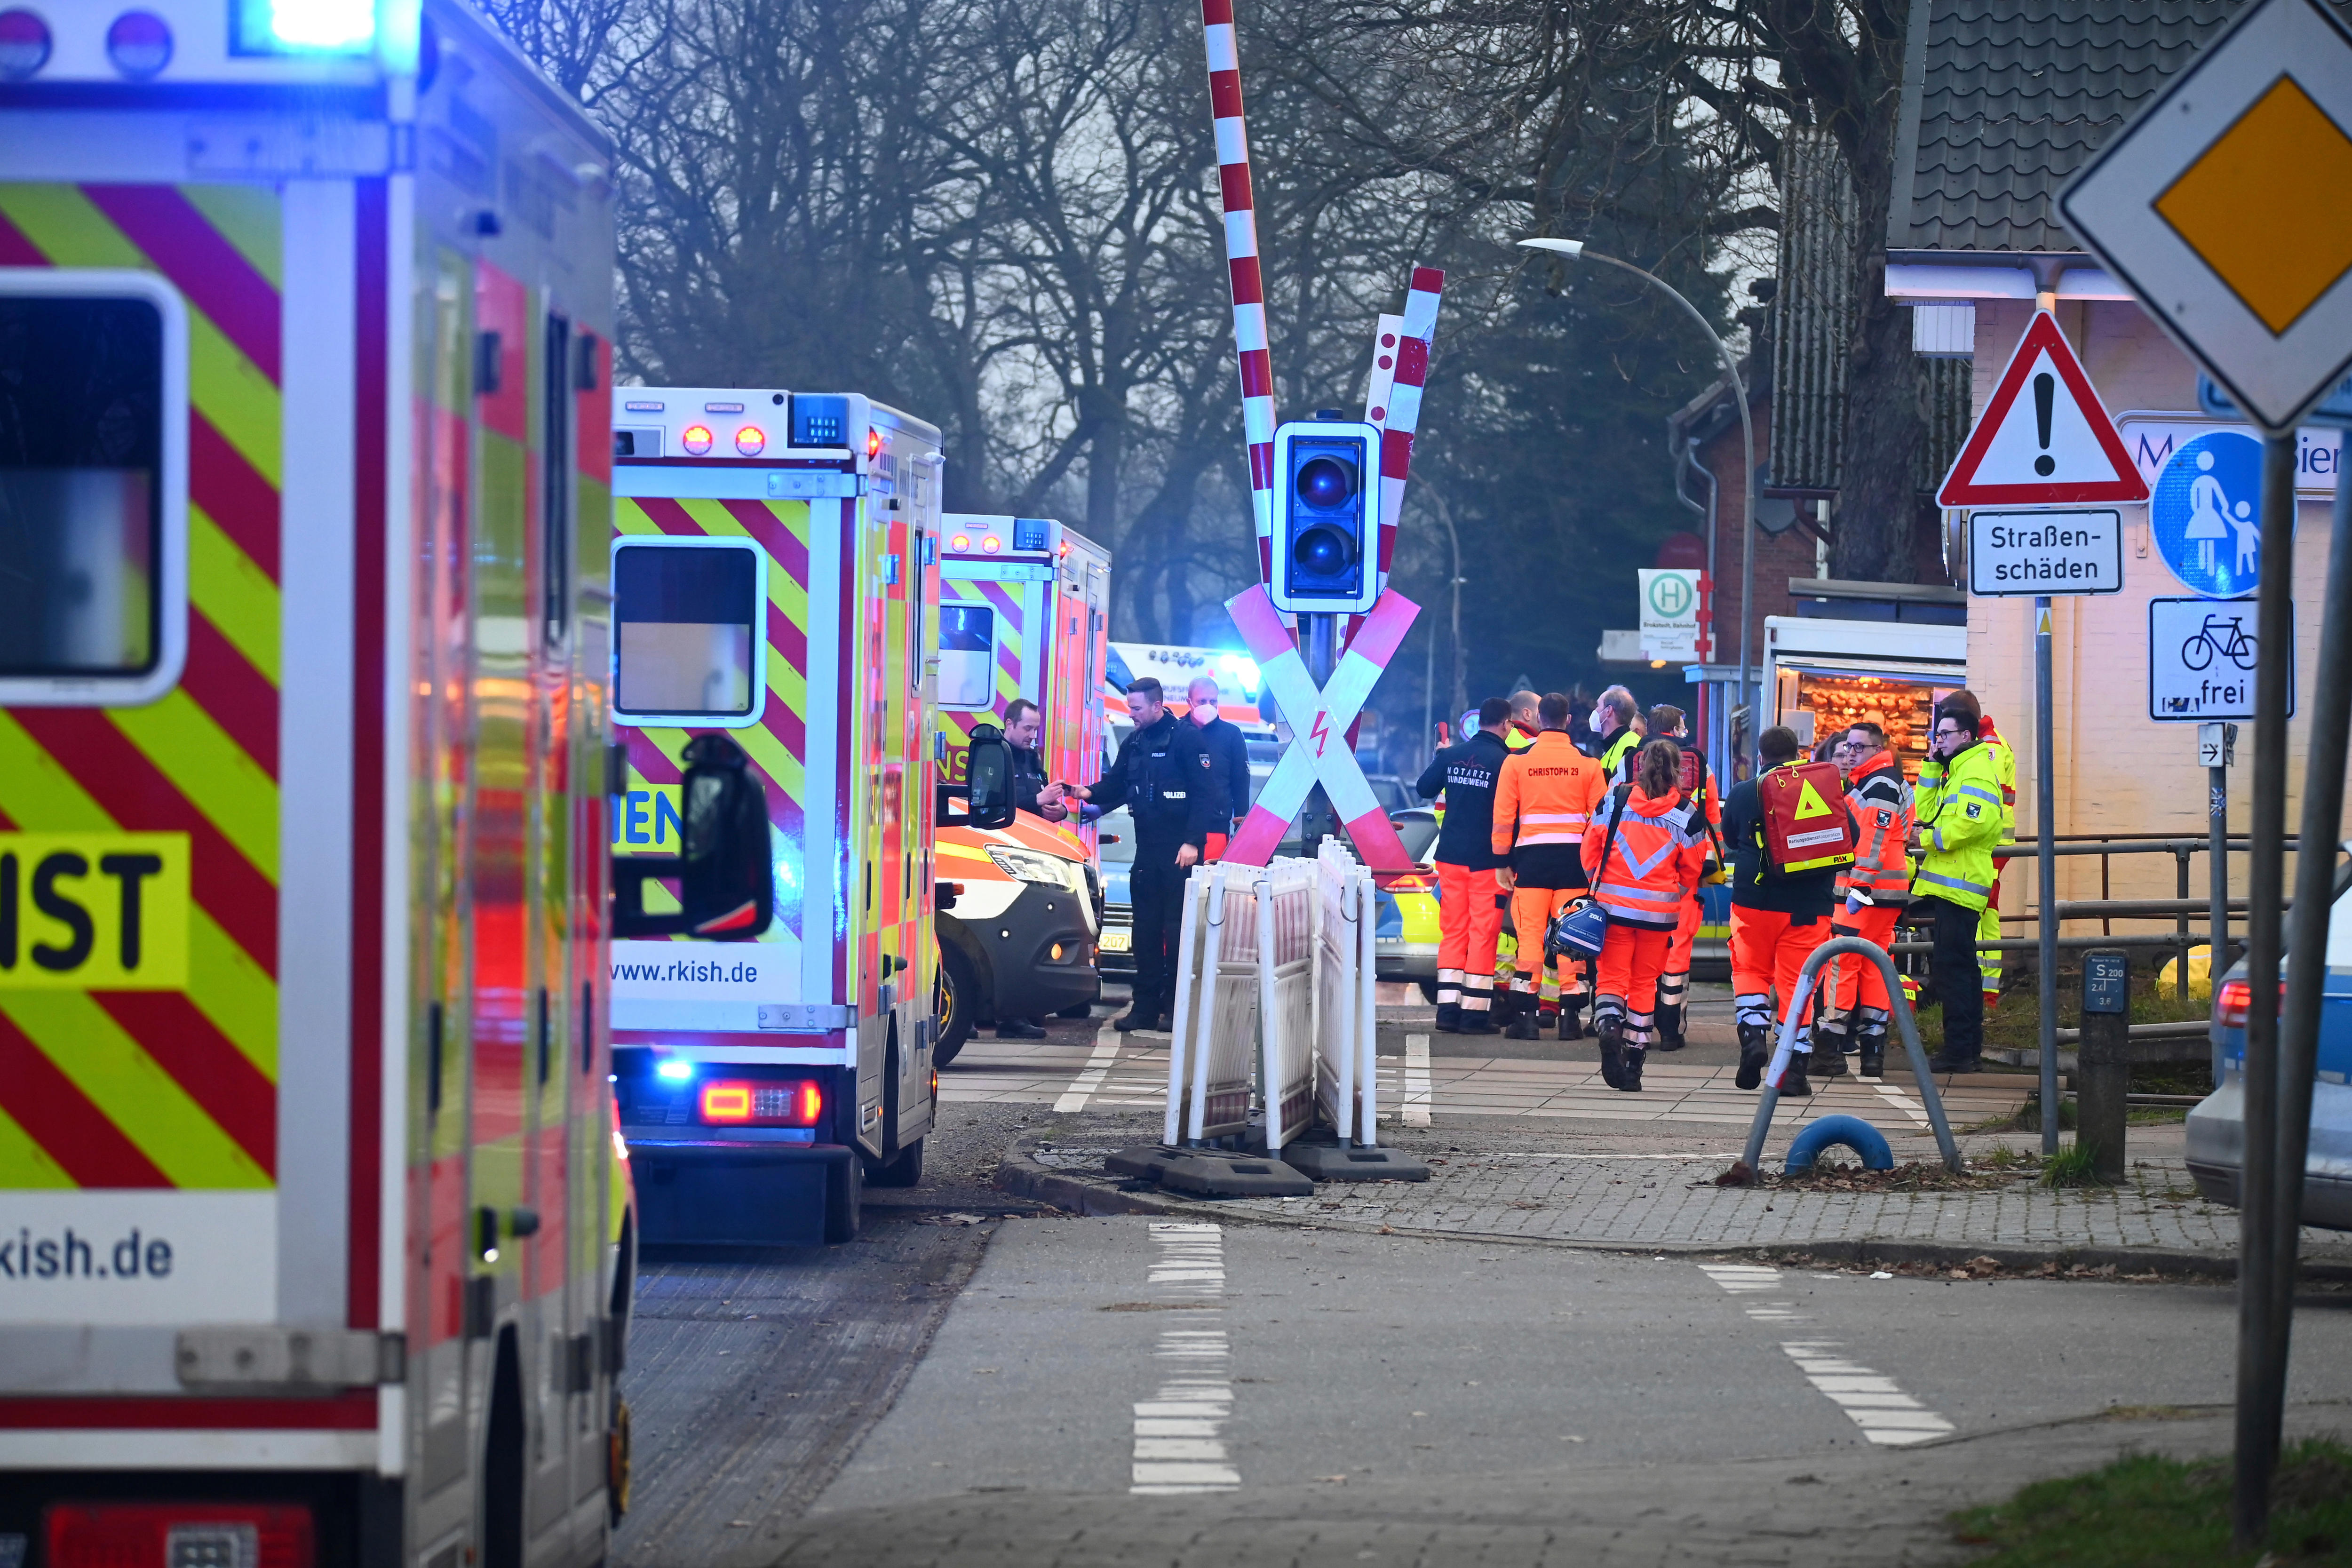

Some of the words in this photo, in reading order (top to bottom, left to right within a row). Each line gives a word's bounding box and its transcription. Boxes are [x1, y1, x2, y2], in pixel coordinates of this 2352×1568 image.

[1991, 525, 2101, 548] Straßen-
[1995, 557, 2098, 580] schäden
[2201, 679, 2244, 704] frei
[1447, 766, 1491, 780] NOTARZT
[1528, 768, 1568, 777] CHRISTOPH
[1589, 913, 1603, 922] ZOLL
[1104, 936, 1125, 948] 207
[2096, 964, 2106, 976] S
